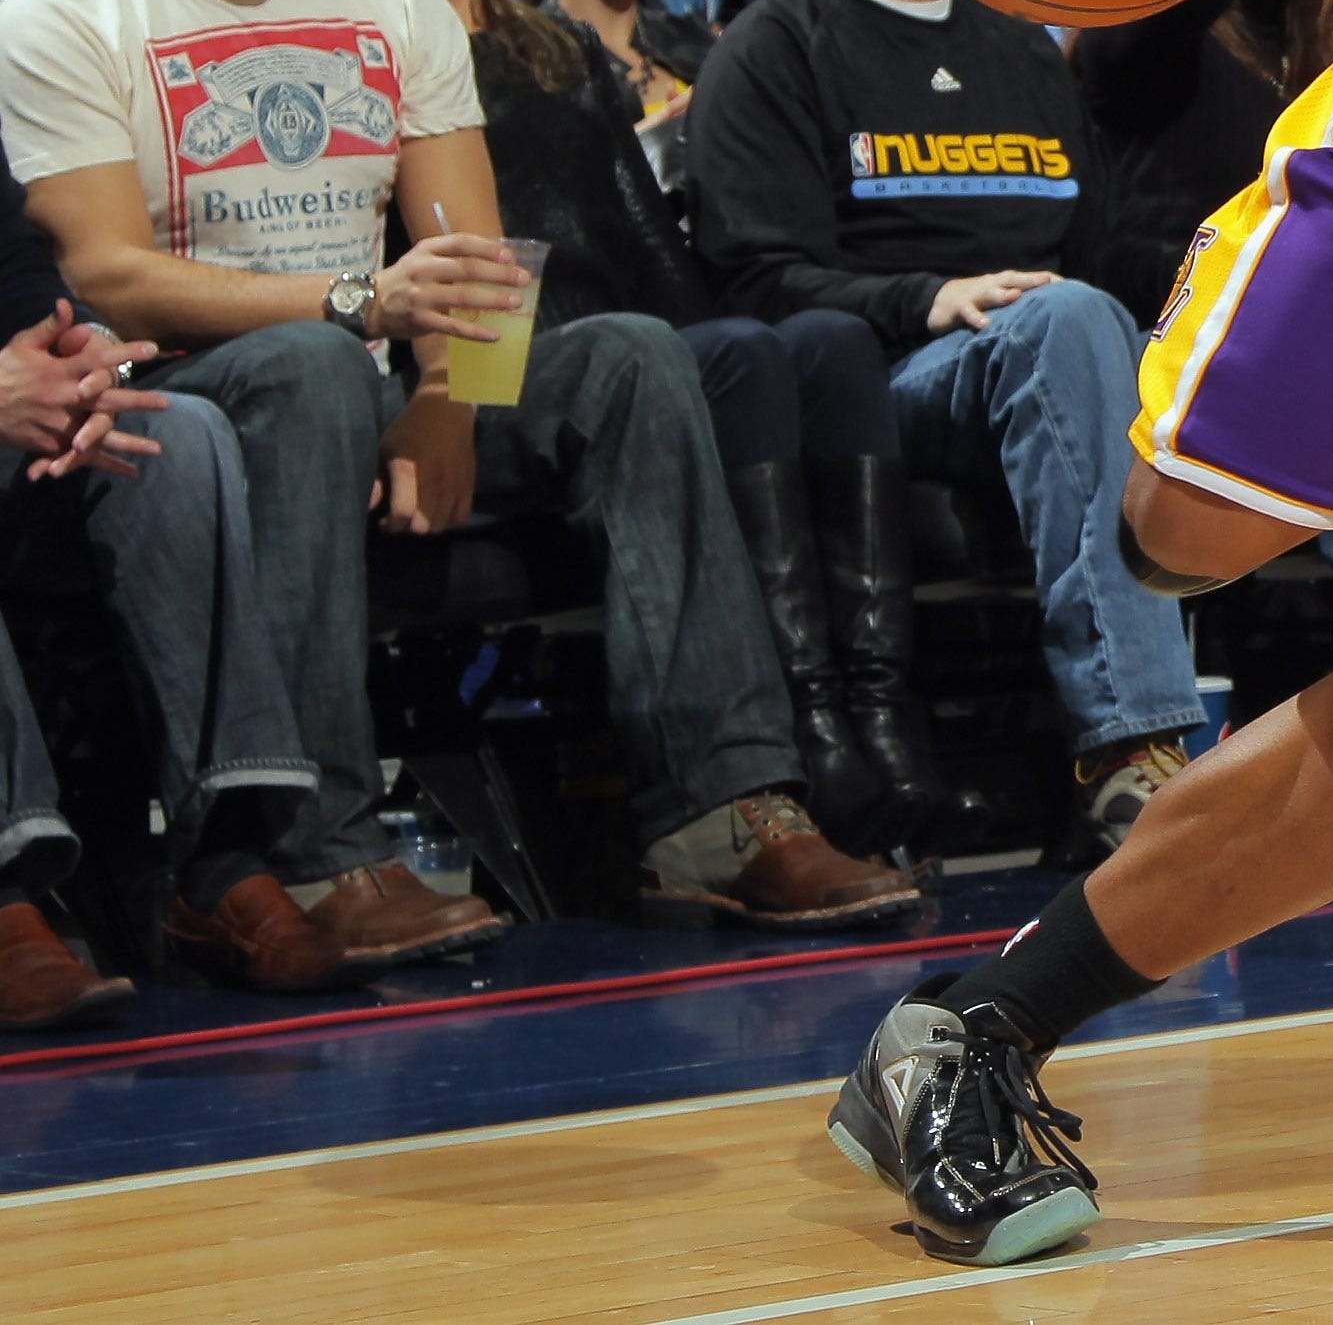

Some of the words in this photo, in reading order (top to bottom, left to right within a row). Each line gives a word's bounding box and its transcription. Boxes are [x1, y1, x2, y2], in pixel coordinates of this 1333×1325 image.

[873, 133, 1071, 178] NUGGETS
[202, 181, 381, 224] Budweiser
[874, 181, 1057, 194] BASKETBAL
